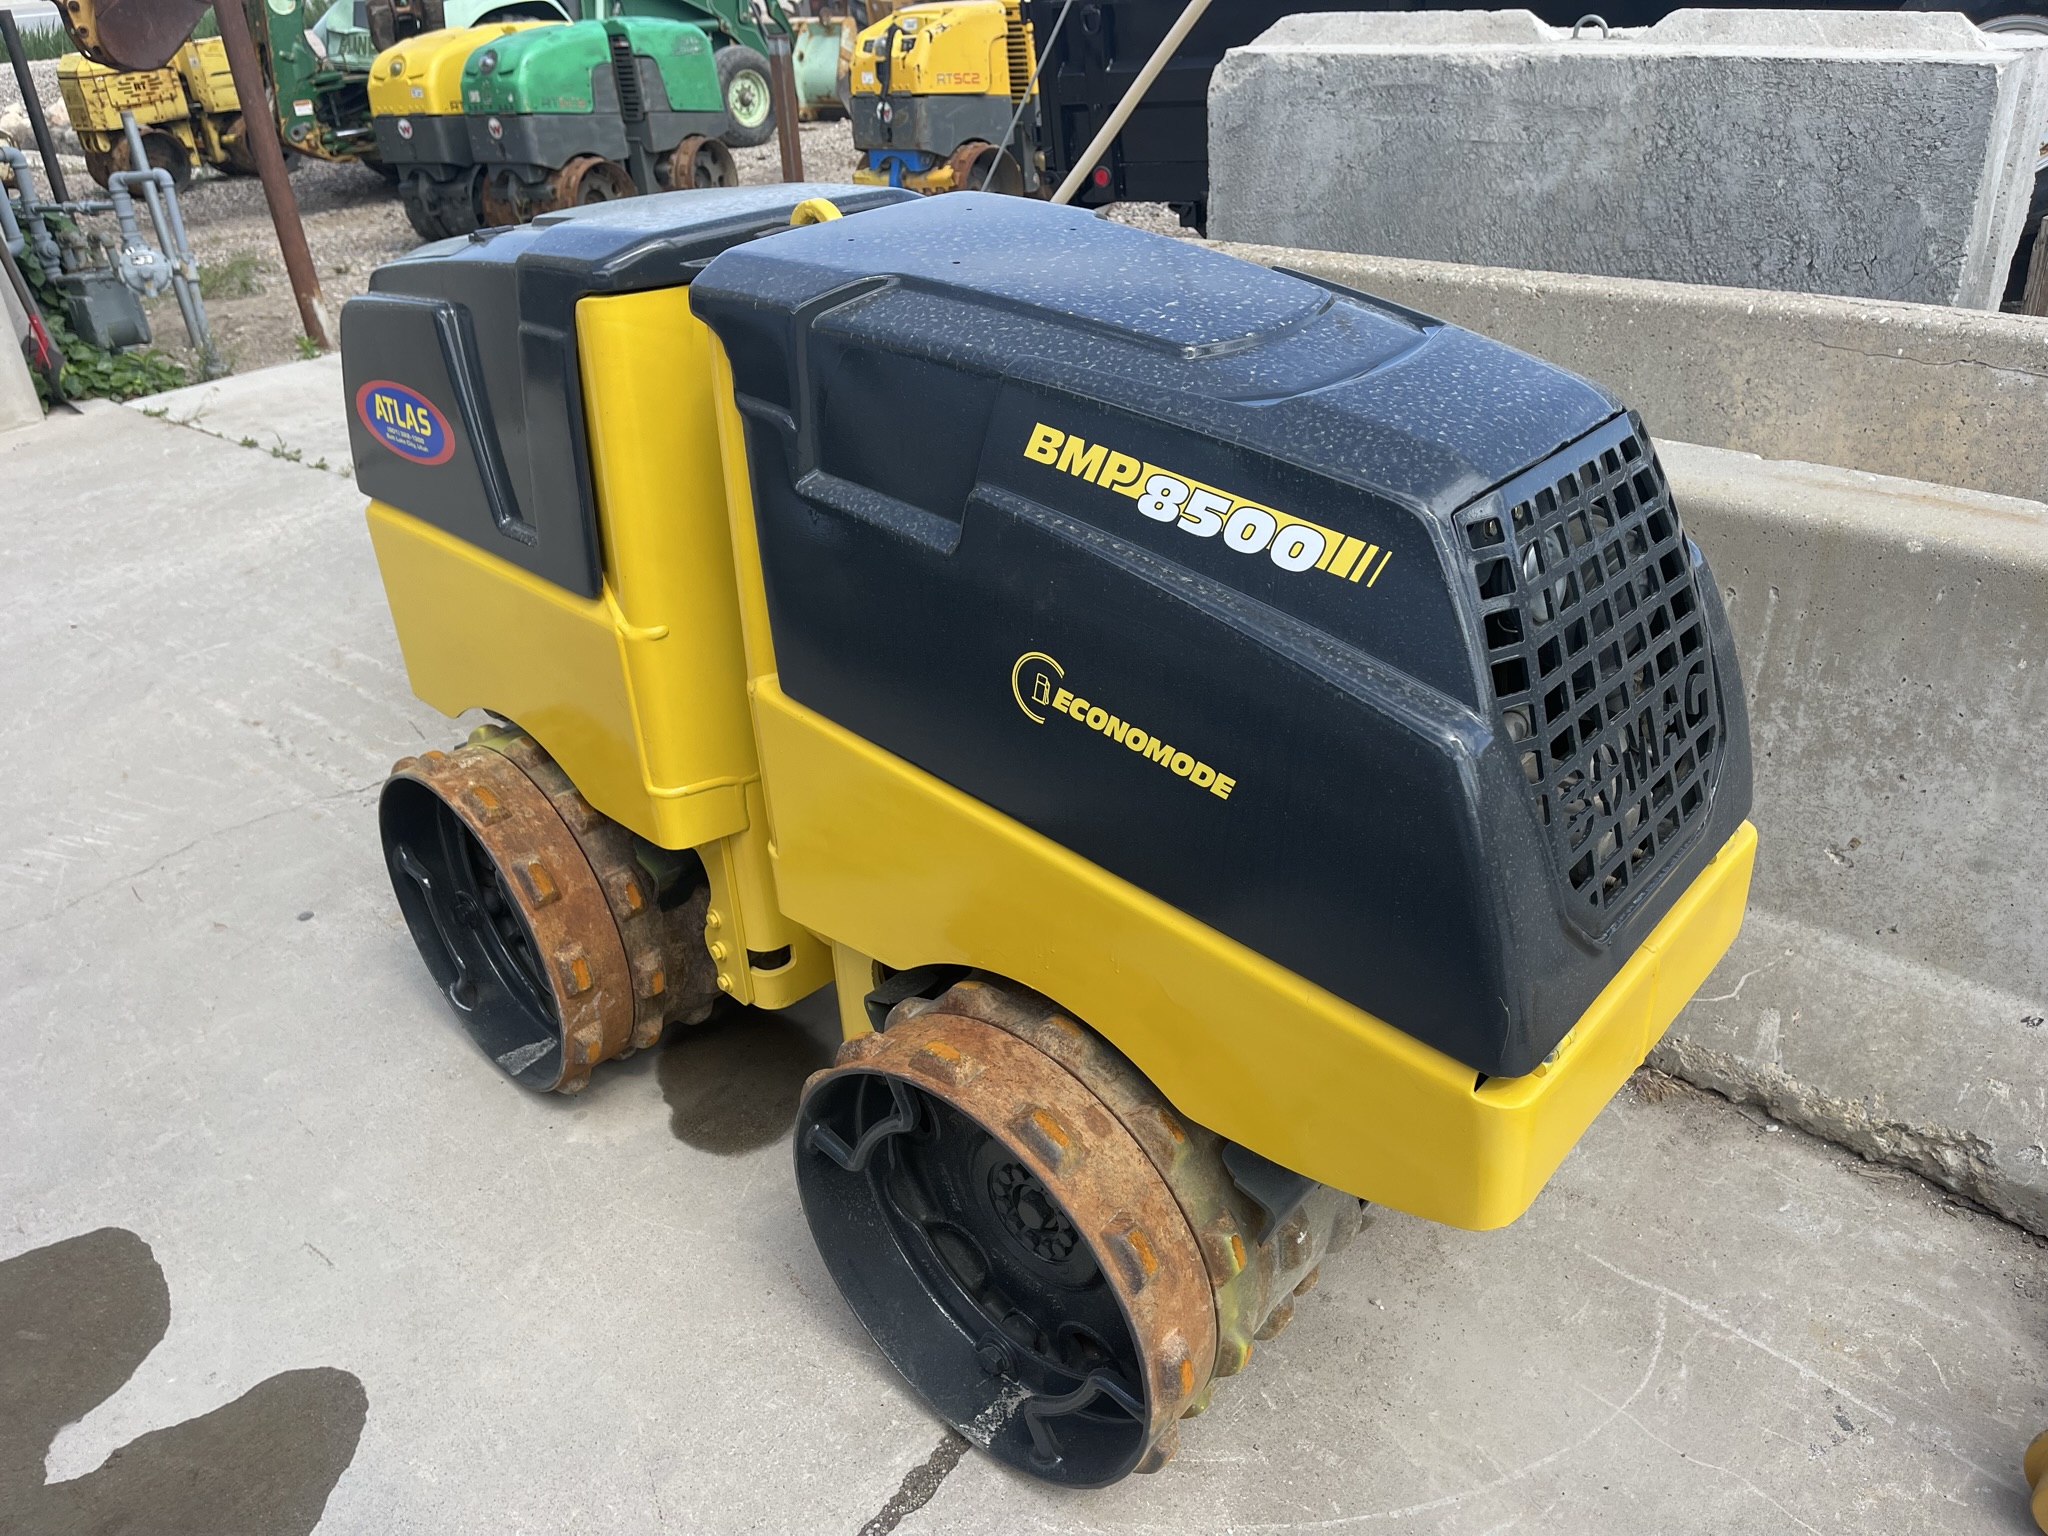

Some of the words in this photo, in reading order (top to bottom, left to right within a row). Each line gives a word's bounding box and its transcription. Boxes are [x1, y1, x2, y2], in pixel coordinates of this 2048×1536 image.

[374, 392, 432, 437] ATLAS
[1051, 686, 1237, 801] ECONOMODE
[1555, 658, 1710, 854] BOMAG
